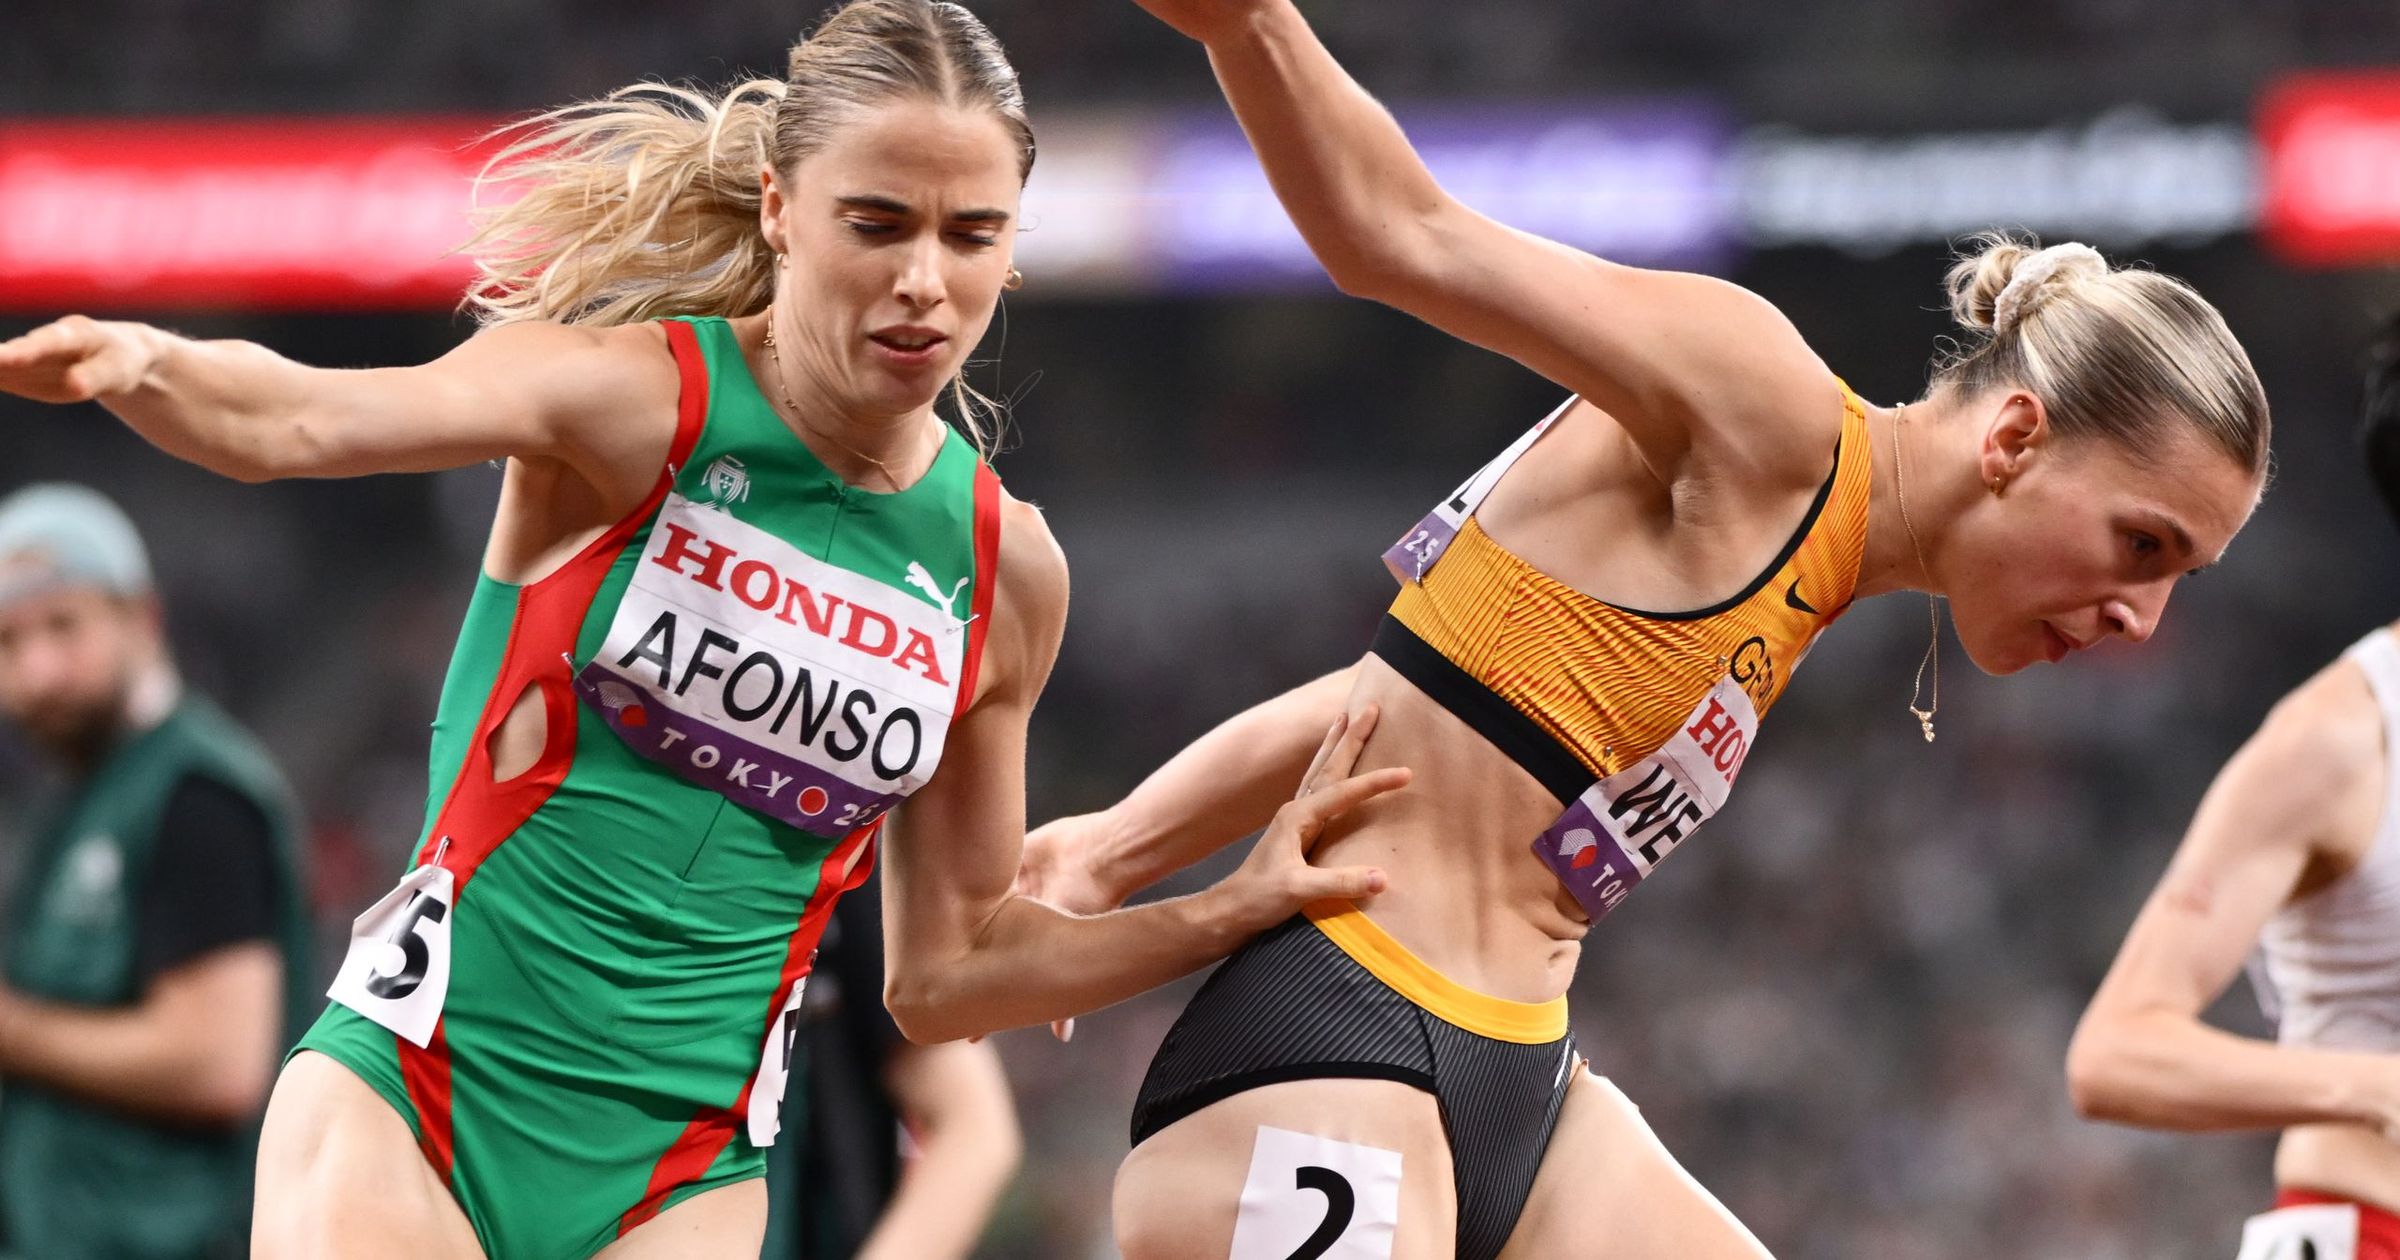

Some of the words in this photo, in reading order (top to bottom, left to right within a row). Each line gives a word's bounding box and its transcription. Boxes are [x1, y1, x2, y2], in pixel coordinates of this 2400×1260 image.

[651, 522, 950, 687] HONDA
[616, 610, 922, 781] AFONSO
[365, 888, 447, 1000] 5
[1285, 1165, 1355, 1260] 2
